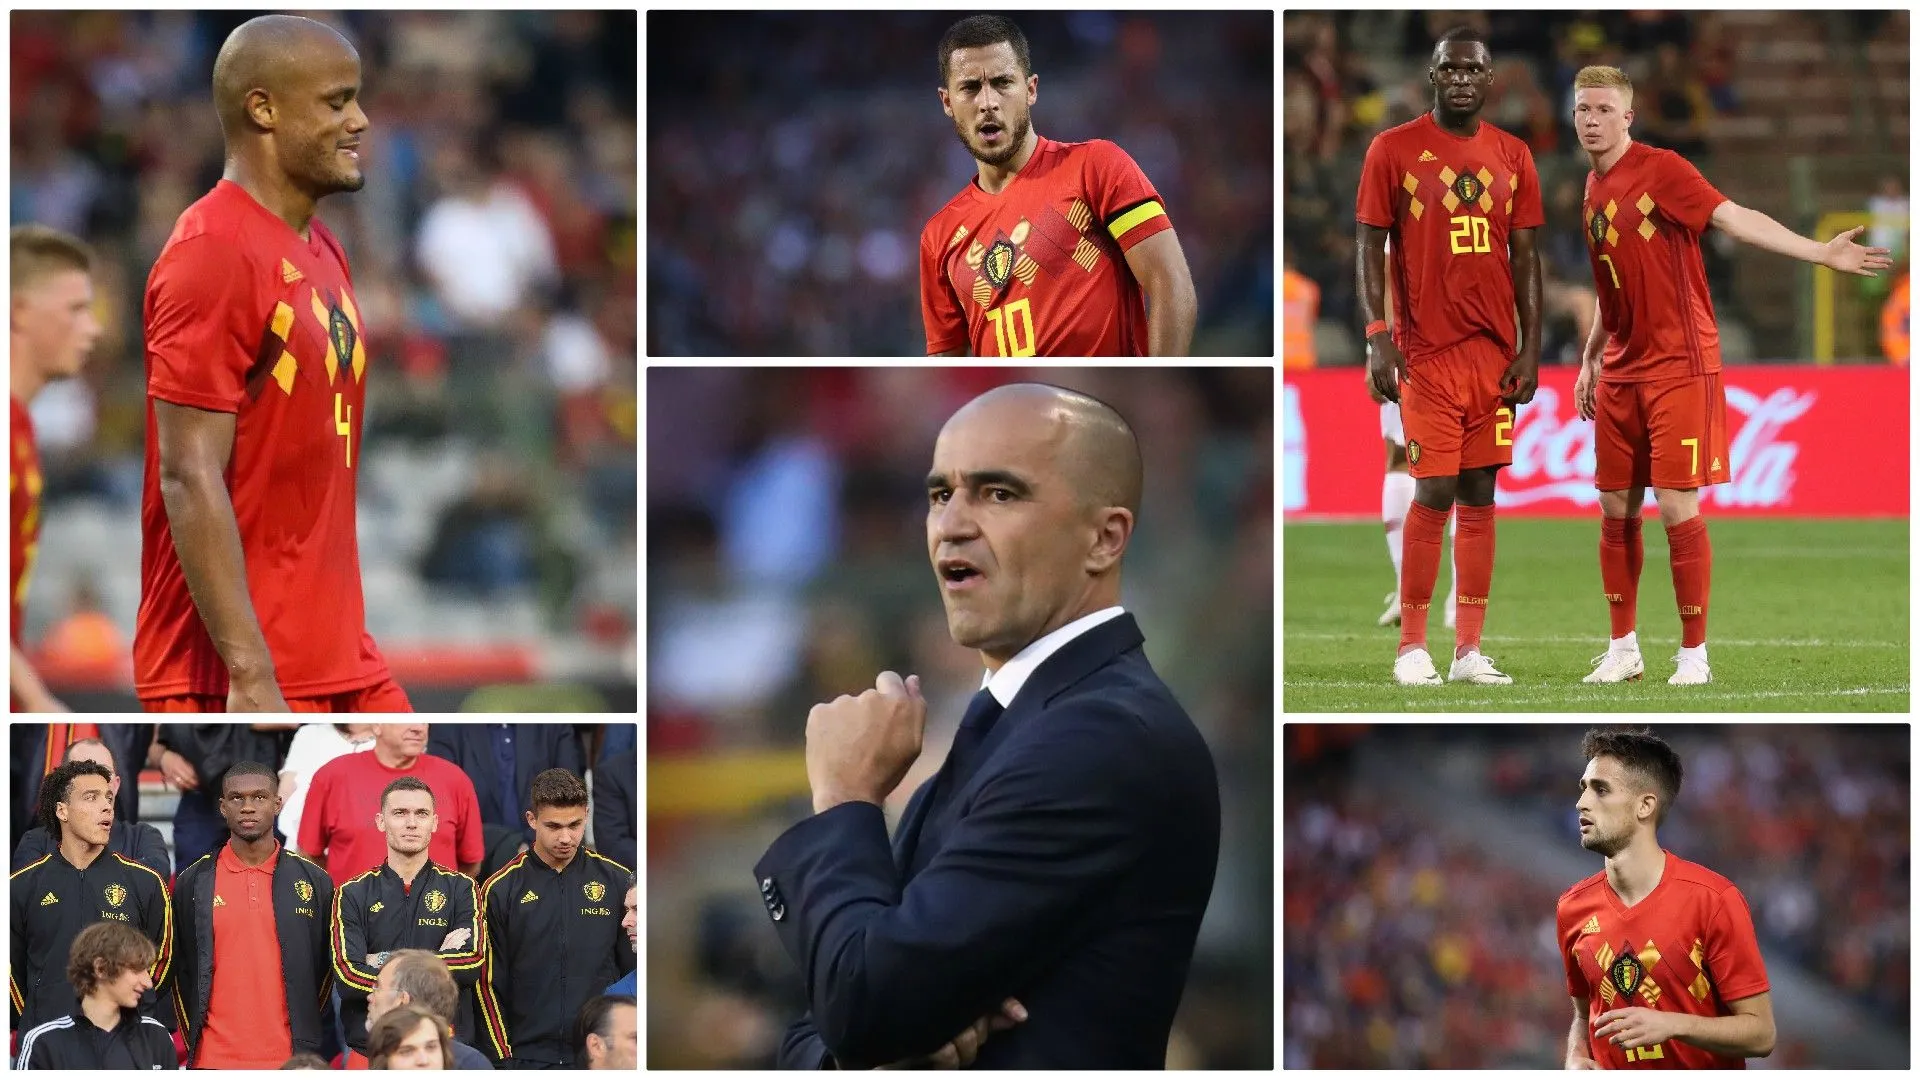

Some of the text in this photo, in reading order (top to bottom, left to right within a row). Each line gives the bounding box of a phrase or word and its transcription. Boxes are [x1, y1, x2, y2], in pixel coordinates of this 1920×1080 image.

[1450, 215, 1491, 255] 20
[1598, 254, 1620, 289] 7
[985, 297, 1036, 357] 10
[334, 392, 352, 468] 4
[1681, 438, 1698, 476] 7
[418, 918, 436, 926] ING
